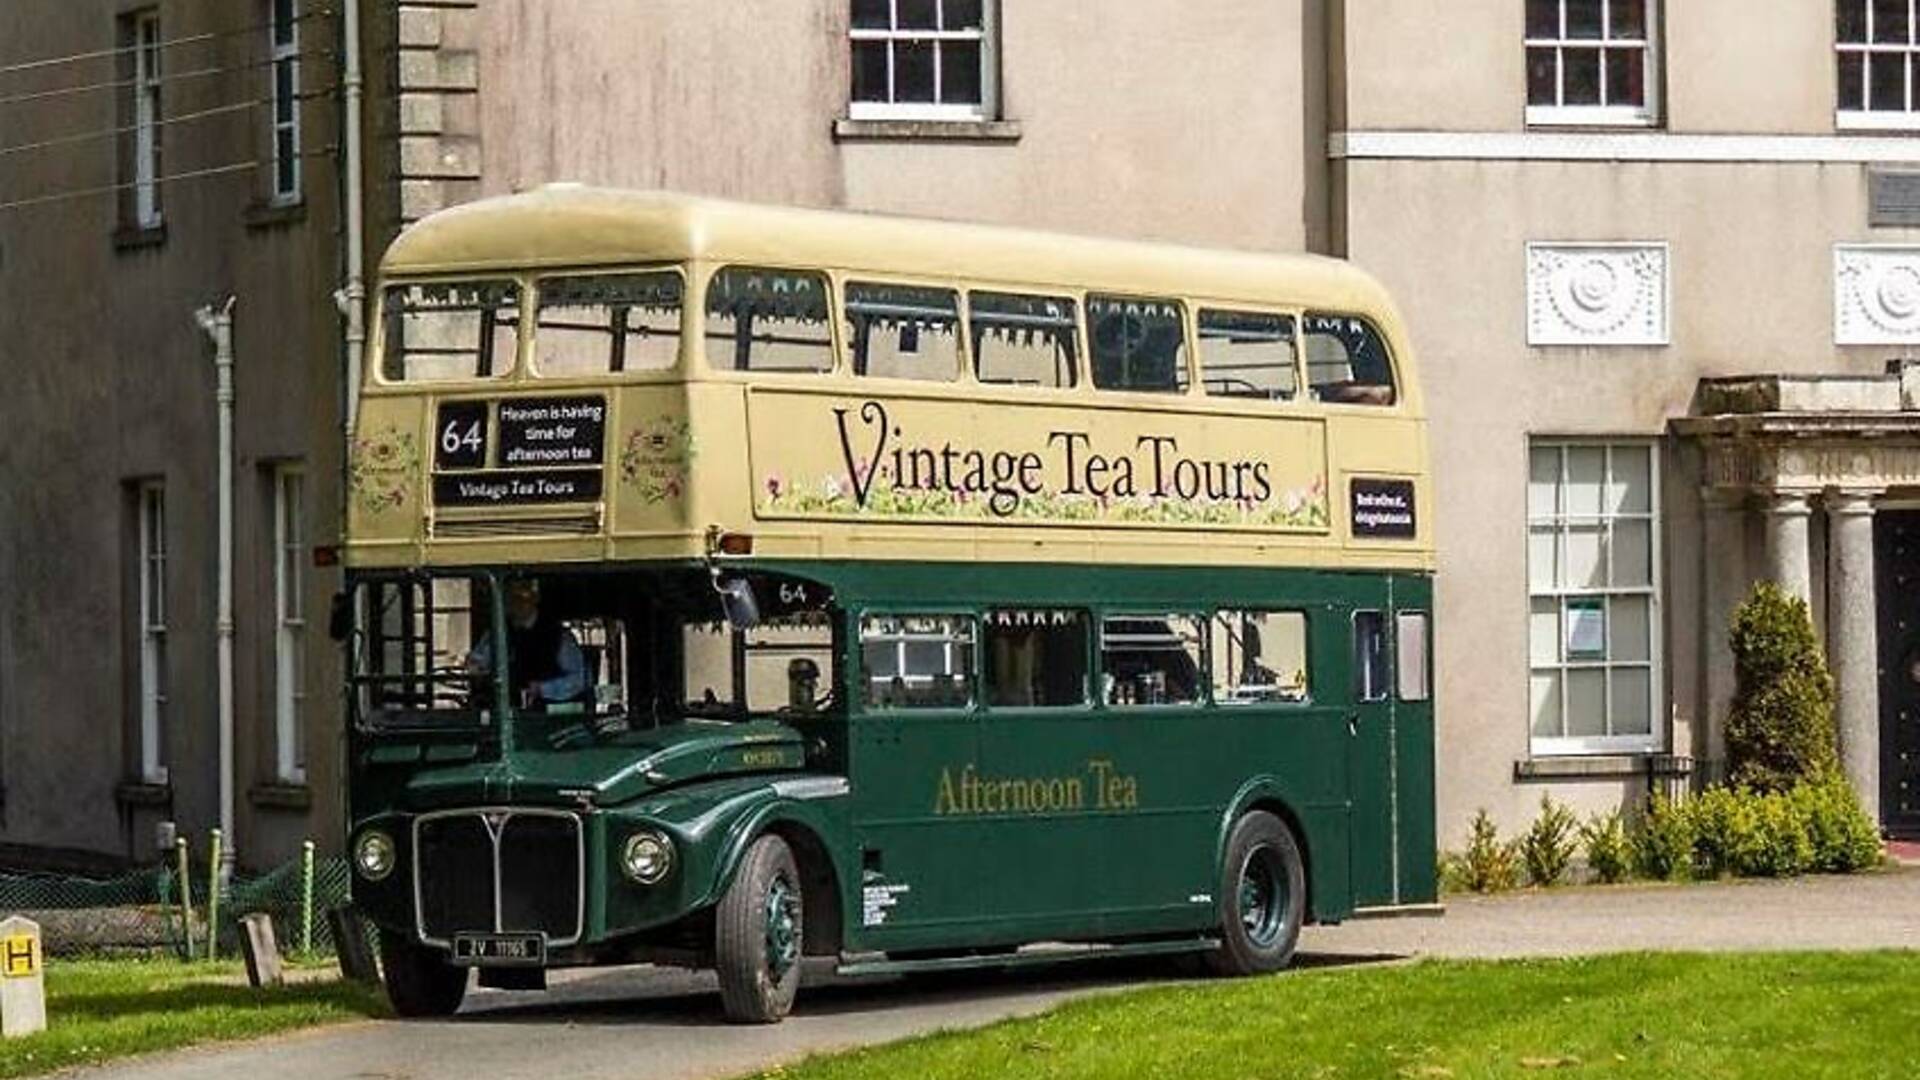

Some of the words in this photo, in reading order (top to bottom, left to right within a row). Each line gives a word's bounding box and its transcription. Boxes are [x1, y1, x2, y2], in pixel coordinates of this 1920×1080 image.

[501, 406, 549, 420] Heaven
[550, 404, 559, 419] is
[561, 404, 602, 422] having
[442, 419, 483, 453] 64
[525, 427, 554, 440] time
[556, 424, 576, 439] for
[507, 447, 570, 461] afternoon
[572, 446, 592, 459] tea
[833, 401, 1044, 517] Vintage
[1047, 431, 1137, 498] Tea
[1136, 436, 1272, 502] Tours
[459, 481, 508, 499] Vintage
[511, 480, 534, 495] Tea
[536, 479, 574, 495] Tours
[779, 583, 807, 603] 64
[934, 763, 1083, 815] Afternoon
[1087, 760, 1138, 809] Tea
[6, 938, 33, 972] H
